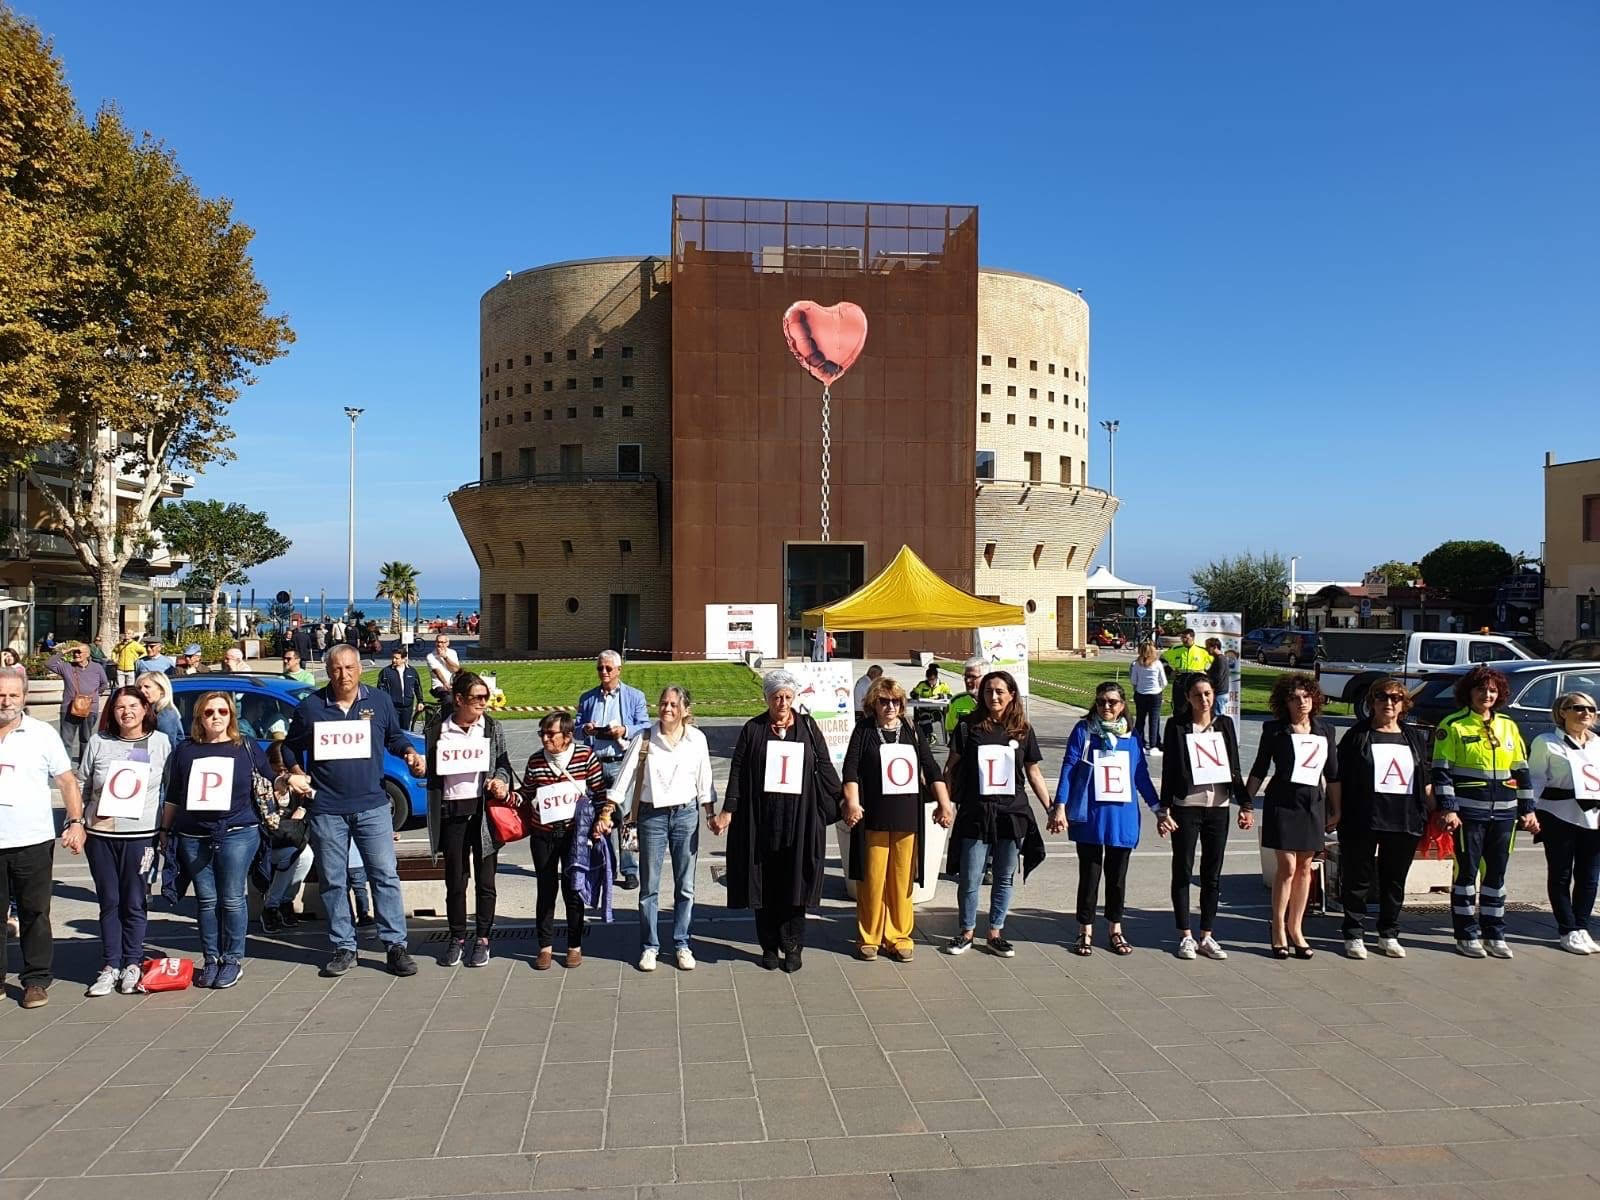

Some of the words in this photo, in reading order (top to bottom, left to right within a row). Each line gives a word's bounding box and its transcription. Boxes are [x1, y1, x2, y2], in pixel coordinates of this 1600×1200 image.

[320, 732, 365, 746] STOP
[441, 748, 484, 763] STOP
[1194, 739, 1225, 769] N
[1300, 741, 1320, 769] Z
[108, 767, 142, 800] O
[777, 755, 790, 785] I
[886, 757, 914, 787] O
[987, 758, 1009, 787] L
[1103, 765, 1124, 793] E
[1381, 757, 1409, 786] A
[199, 771, 223, 802] P
